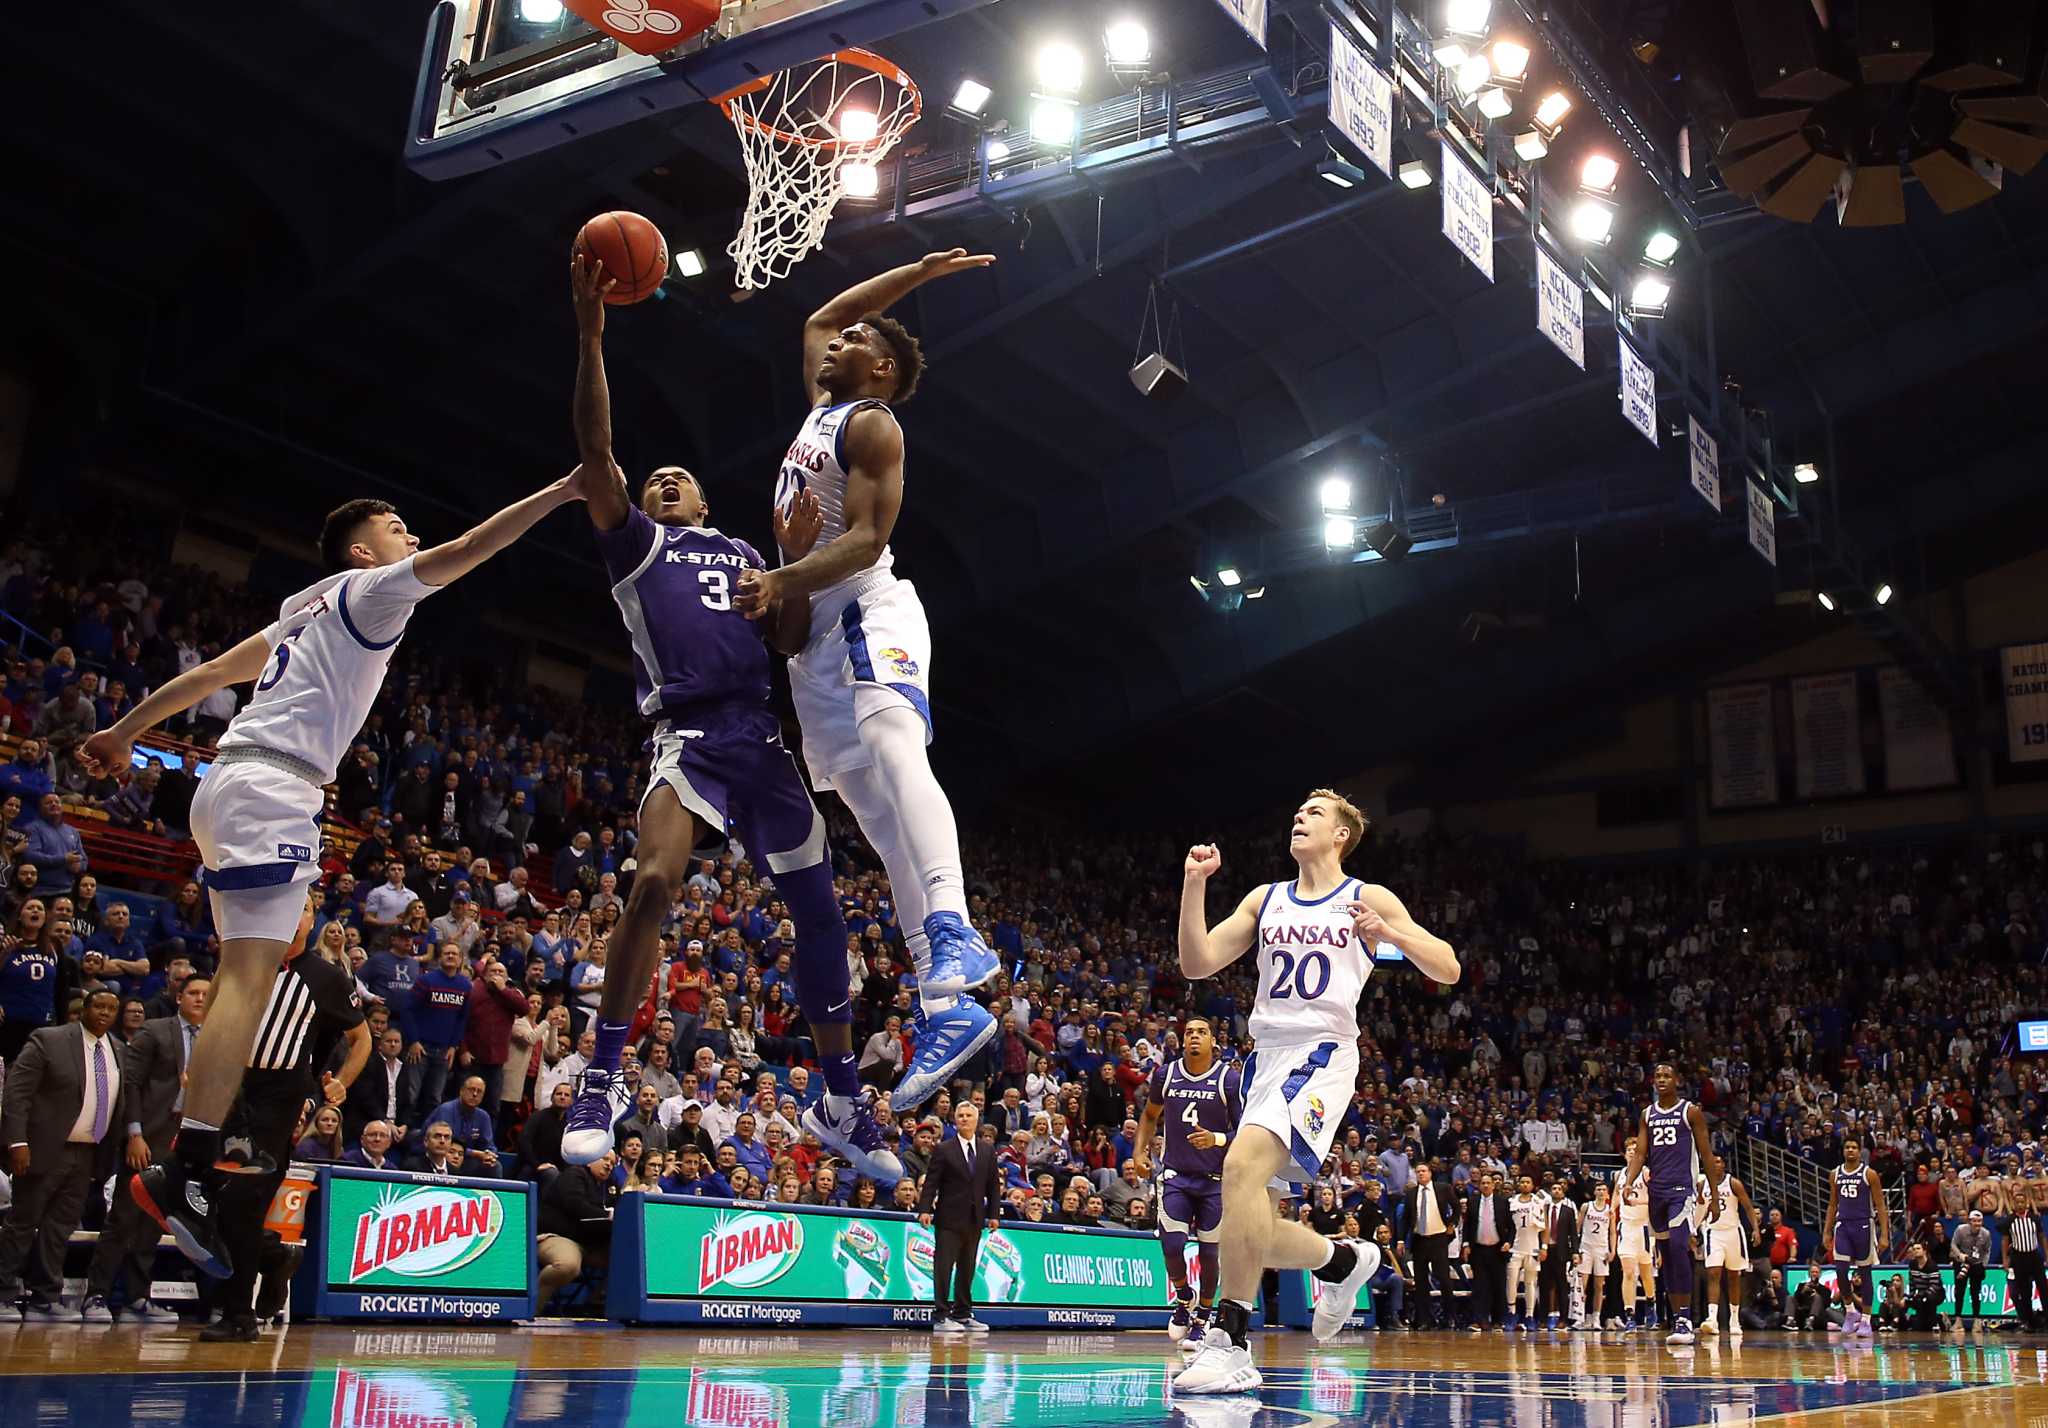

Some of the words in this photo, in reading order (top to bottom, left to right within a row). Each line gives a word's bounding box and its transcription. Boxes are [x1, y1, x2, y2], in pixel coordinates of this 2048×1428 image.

[1350, 109, 1375, 151] 1993
[665, 549, 750, 570] K-STATE
[697, 570, 731, 612] 3
[257, 625, 306, 692] 5
[2022, 723, 2048, 746] 19
[1261, 925, 1350, 949] KANSAS
[30, 963, 45, 980] 0
[1269, 950, 1331, 1000] 20
[431, 991, 465, 1006] KANSAS
[1167, 1088, 1217, 1100] K-STATE
[1181, 1101, 1199, 1127] 4
[1652, 1126, 1677, 1146] 23
[284, 1190, 302, 1210] G
[1840, 1184, 1858, 1198] 45
[1592, 1222, 1600, 1234] 2
[351, 1197, 490, 1282] LIBMAN
[700, 1218, 794, 1292] LIBMAN
[1044, 1253, 1096, 1285] CLEANING
[1095, 1256, 1127, 1287] SINCE
[1126, 1258, 1153, 1288] 1896
[359, 1295, 429, 1313] ROCKET
[431, 1298, 500, 1318] Mortgage
[701, 1303, 751, 1318] ROCKET
[752, 1305, 801, 1323] Mortgage
[893, 1307, 934, 1321] ROCKET
[1047, 1310, 1082, 1323] ROCKET
[1082, 1312, 1117, 1326] Mortgage
